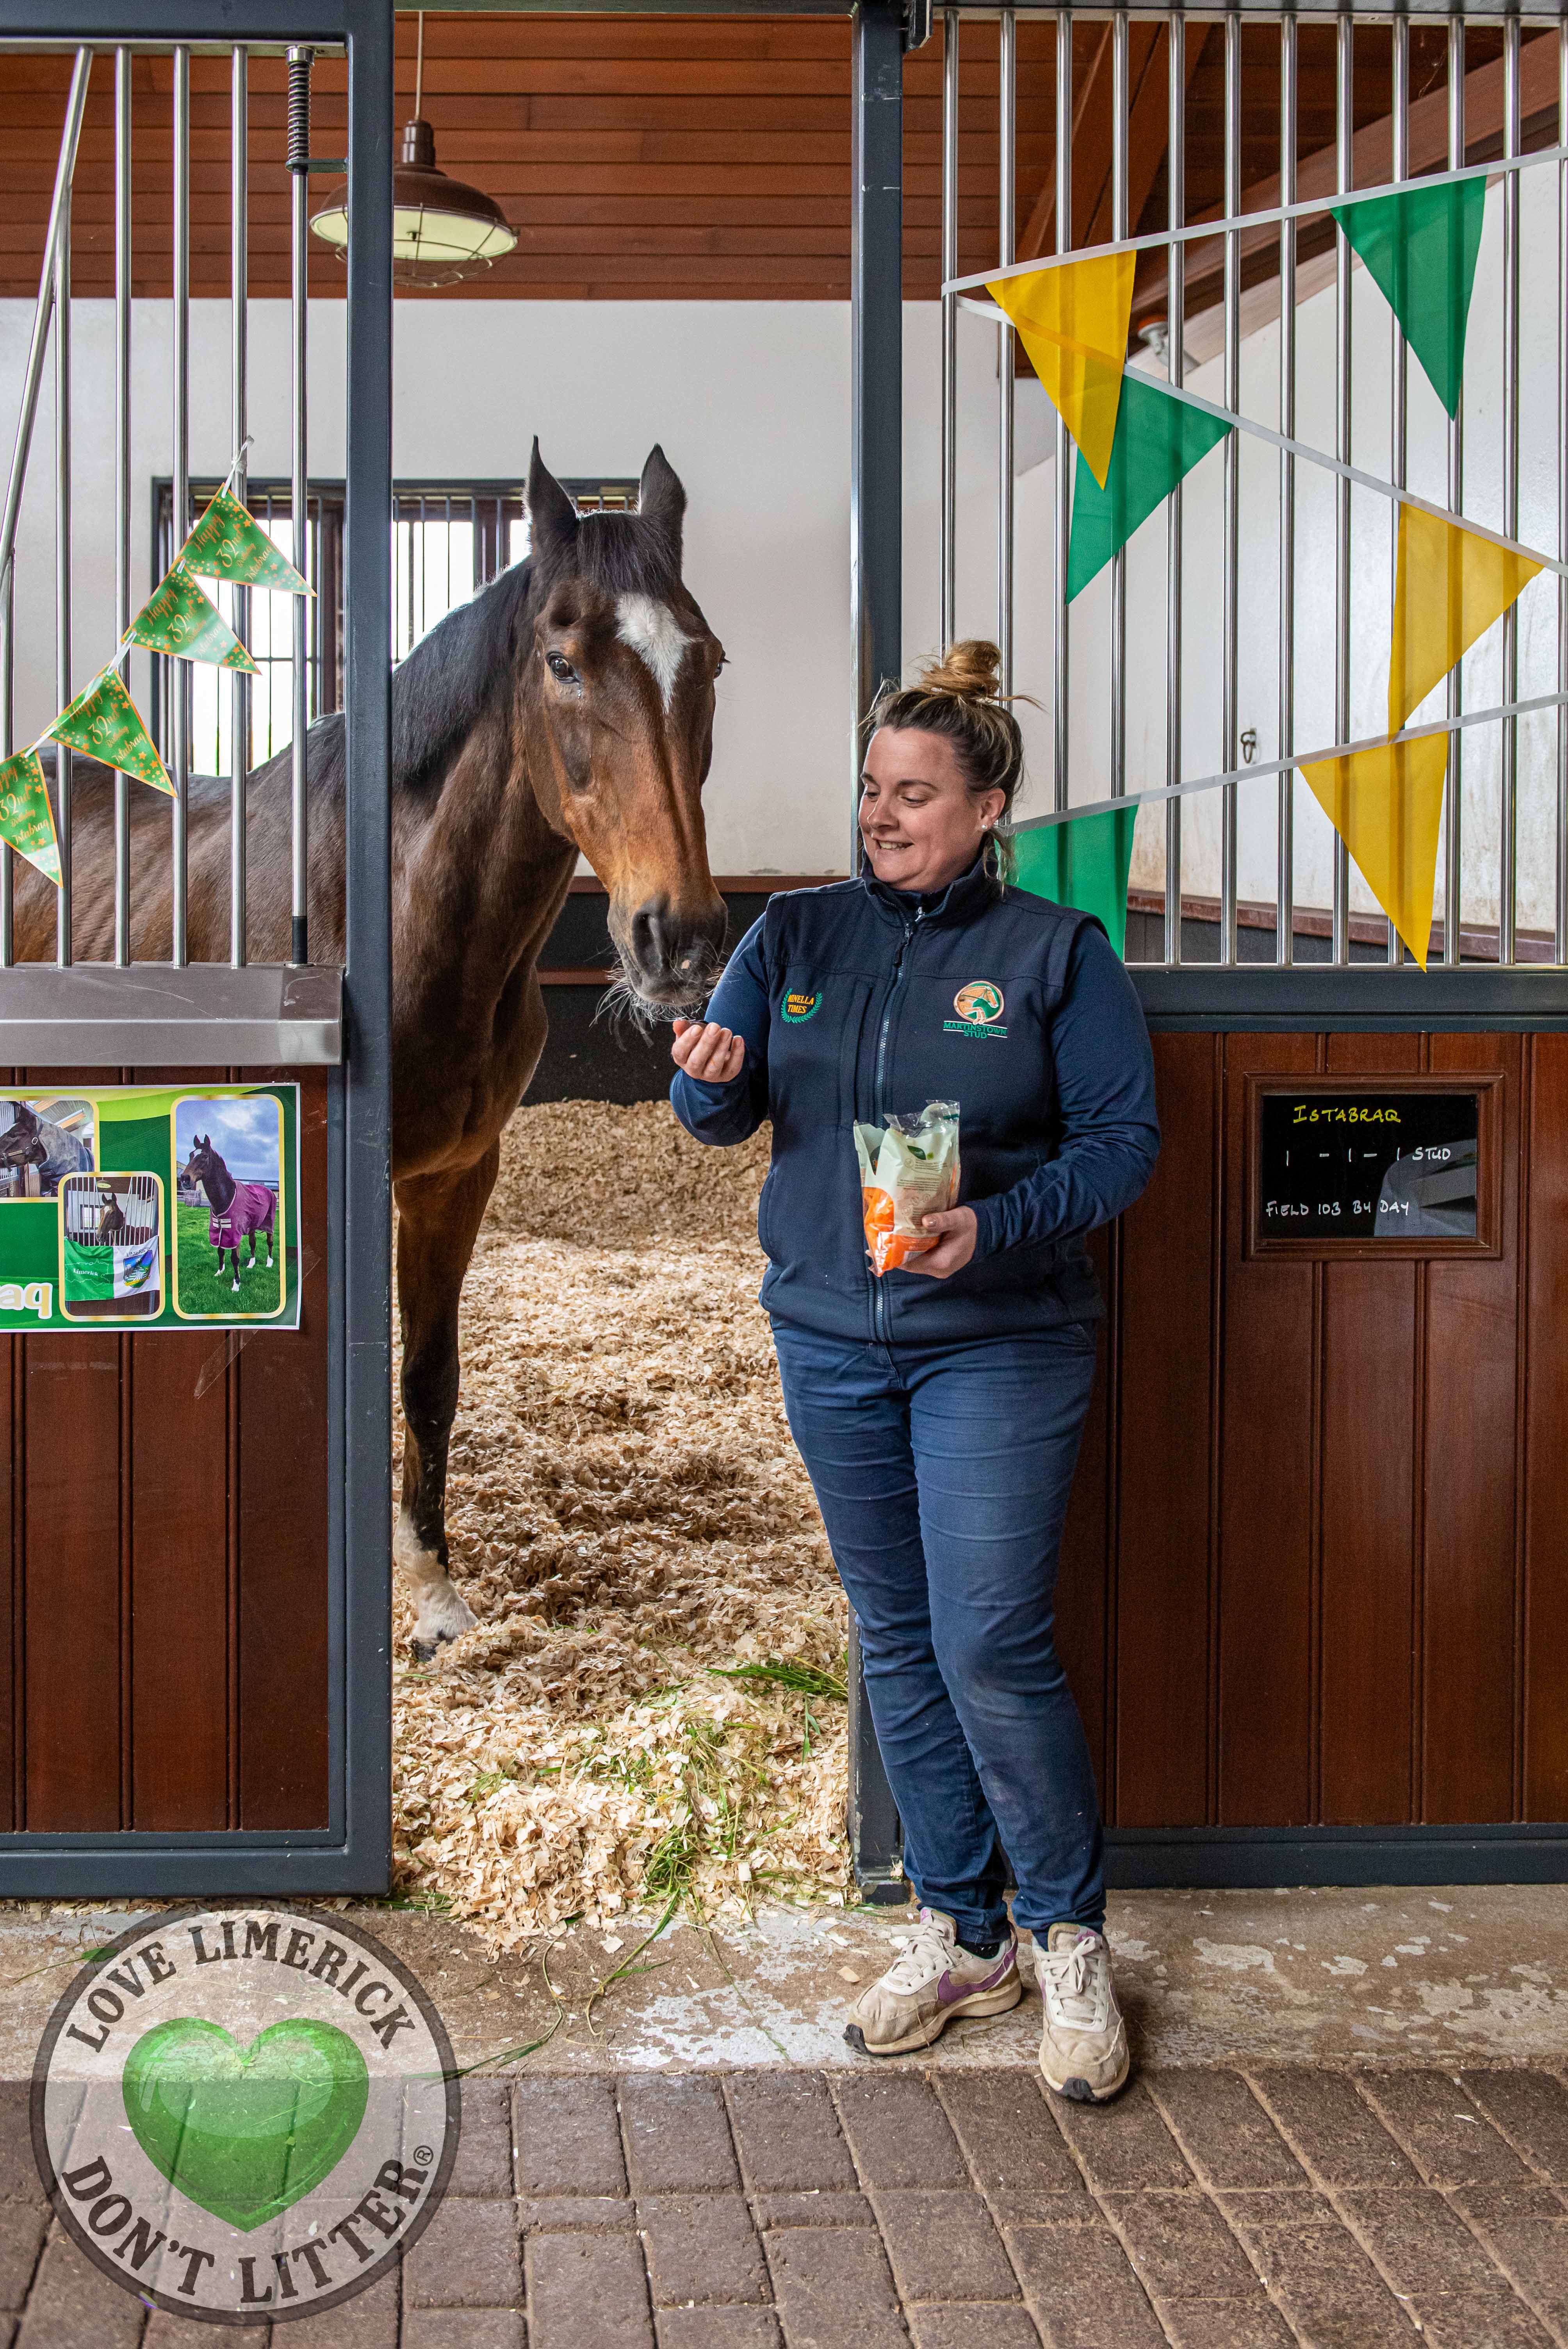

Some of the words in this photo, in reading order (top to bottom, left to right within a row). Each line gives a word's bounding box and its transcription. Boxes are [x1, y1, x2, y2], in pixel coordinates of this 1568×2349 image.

[192, 513, 225, 553] Happy
[215, 524, 244, 567] 32nd
[244, 545, 275, 581] Istabraq
[142, 588, 178, 626] Happy
[167, 599, 197, 643] 32nd
[87, 703, 120, 745] 32nd
[112, 733, 147, 765] Istabraq
[12, 819, 50, 845] Istabraq
[787, 994, 814, 1005] MINELLA
[788, 1004, 807, 1013] TIMES
[943, 1022, 1007, 1035] MARTINSTOWN
[964, 1030, 987, 1039] STUD
[1293, 1105, 1401, 1123] ISTABRAQ
[1412, 1146, 1451, 1161] STUD
[1266, 1200, 1309, 1217] FIELD
[1318, 1201, 1341, 1216] 103
[1380, 1199, 1409, 1216] DAY
[73, 1268, 98, 1276] Limerick
